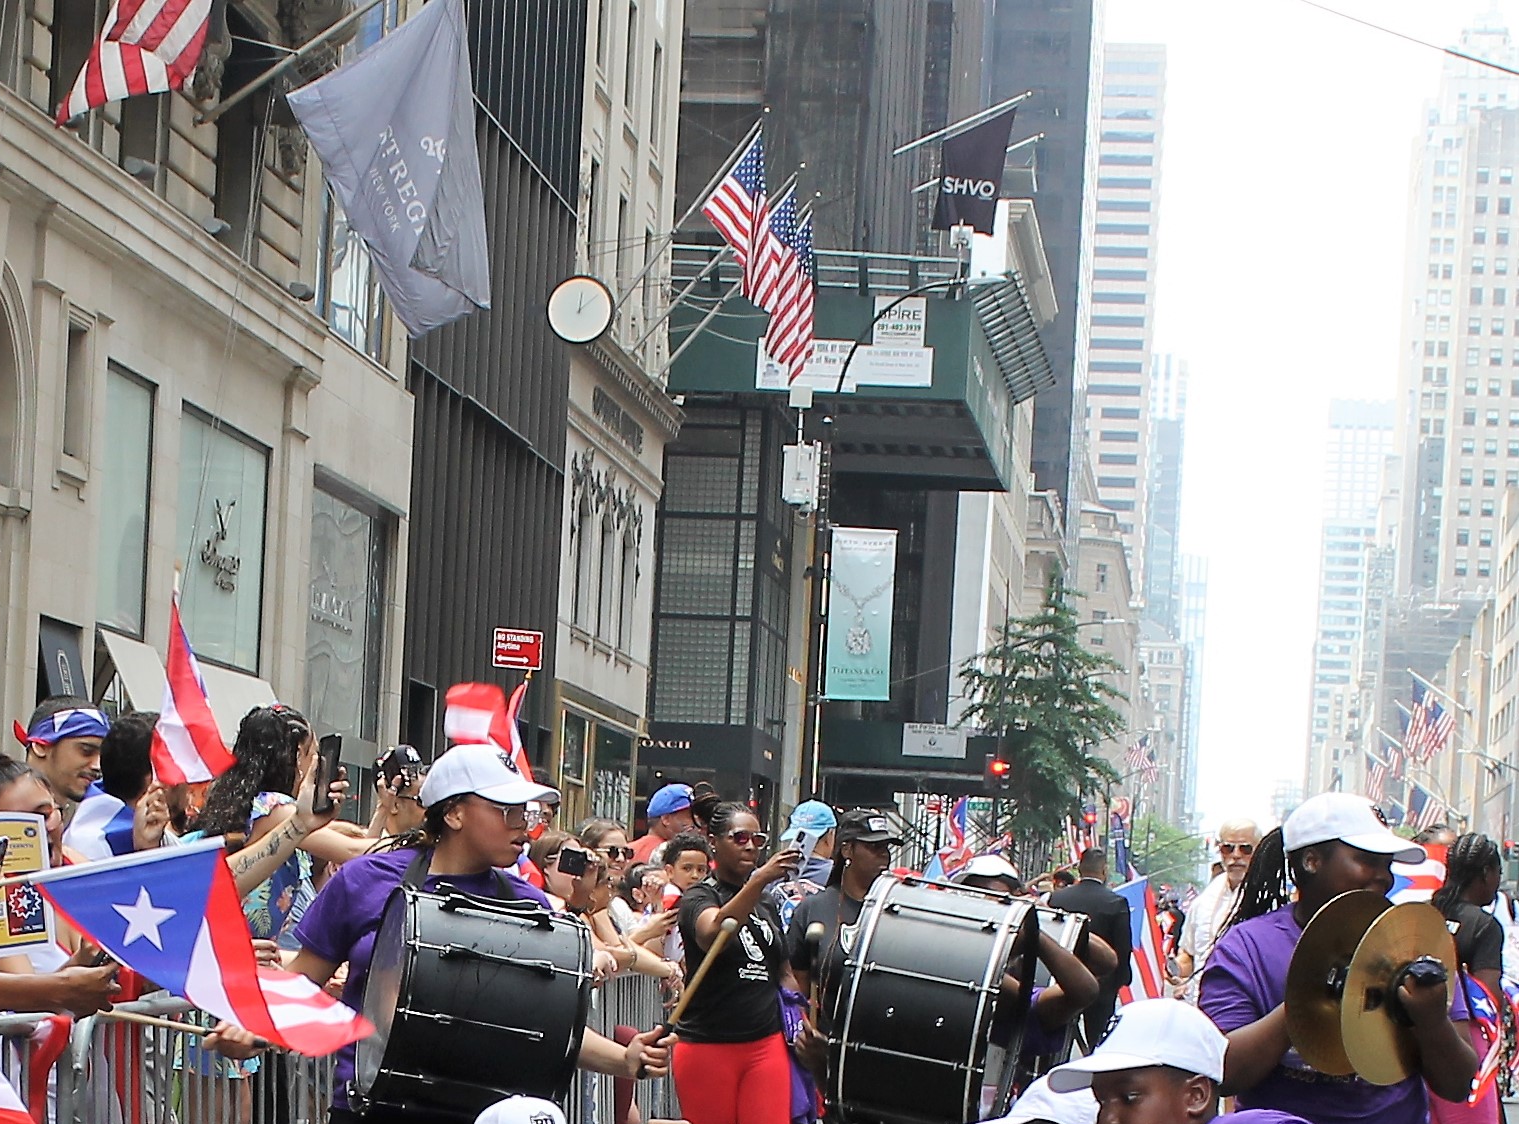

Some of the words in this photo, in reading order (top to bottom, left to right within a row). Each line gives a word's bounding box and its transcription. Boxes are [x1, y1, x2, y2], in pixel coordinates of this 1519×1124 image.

[388, 158, 428, 237] REG
[942, 175, 996, 197] SHVO
[382, 196, 401, 234] YORK
[638, 739, 690, 750] OACH
